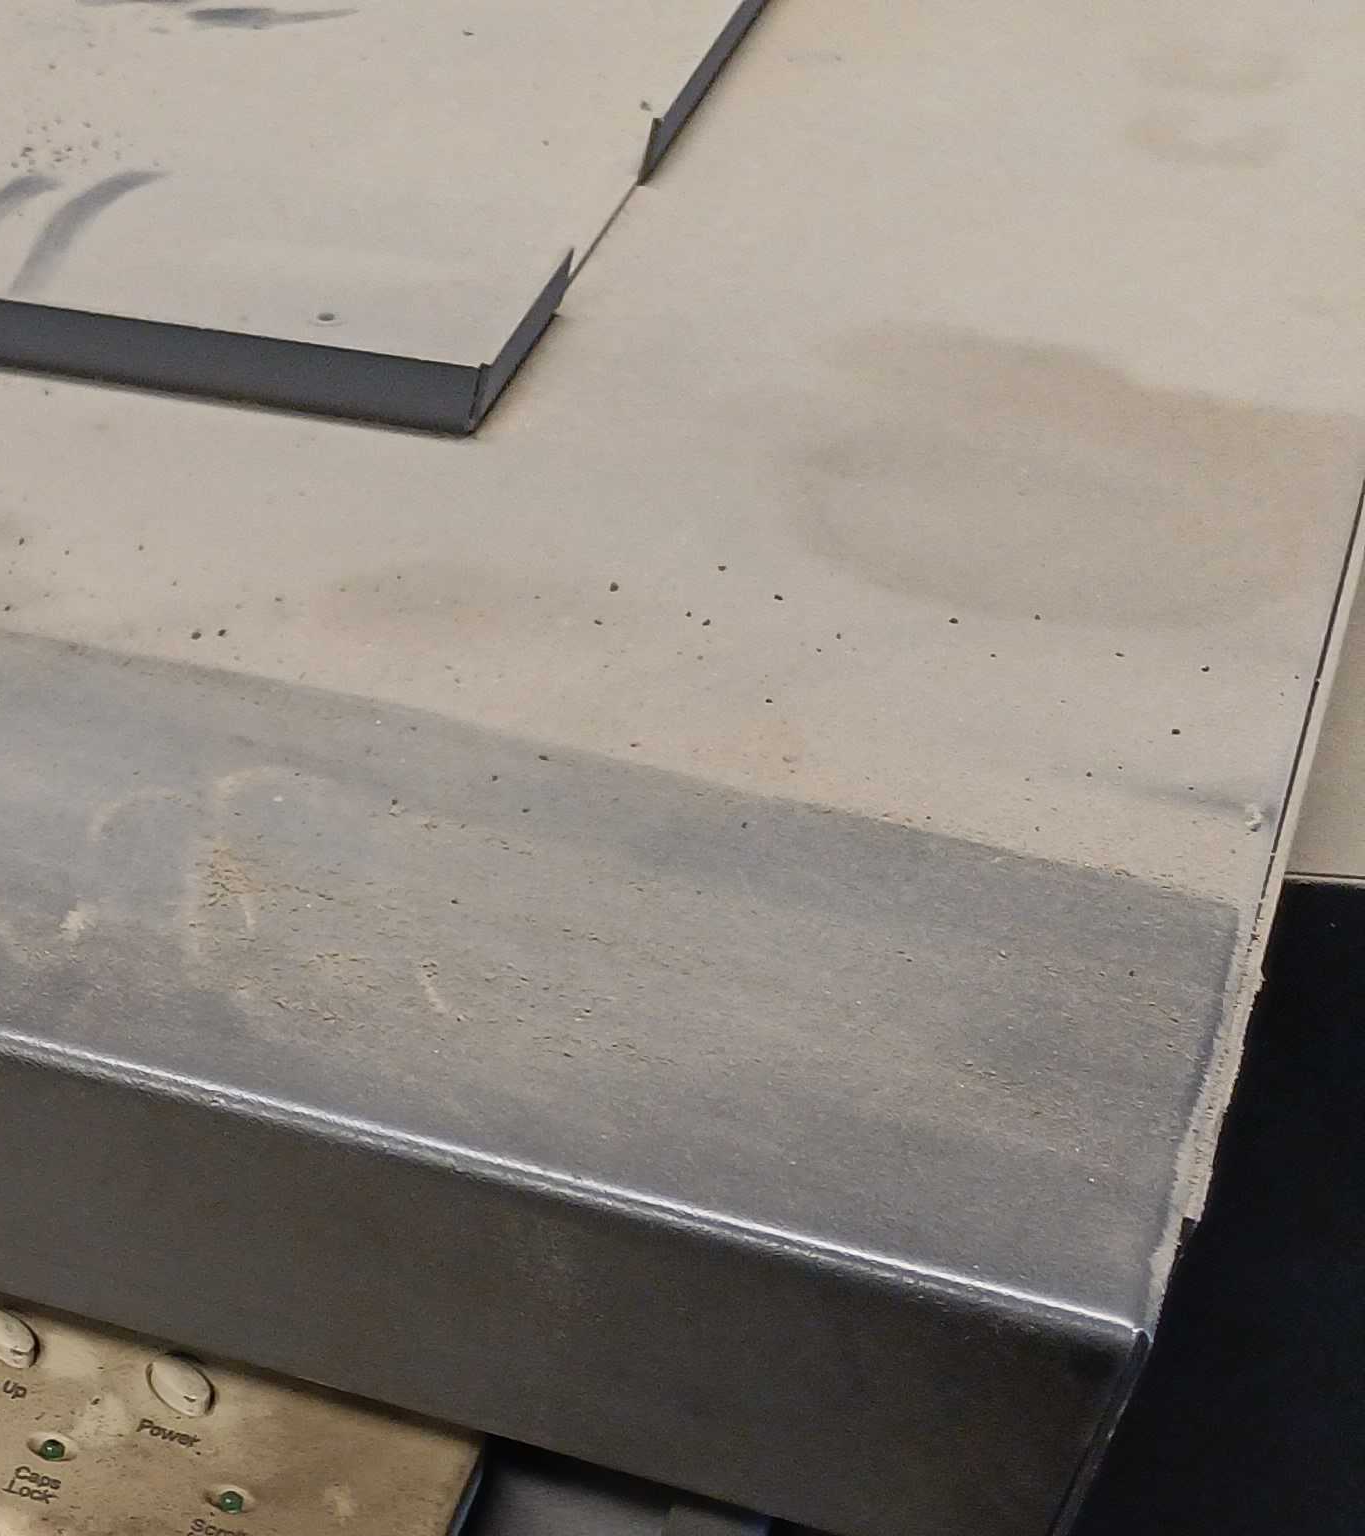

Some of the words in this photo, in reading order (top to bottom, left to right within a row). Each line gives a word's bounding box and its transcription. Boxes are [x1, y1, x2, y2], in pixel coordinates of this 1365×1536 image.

[2, 1380, 28, 1399] Up
[136, 1418, 200, 1448] Power
[15, 1465, 61, 1490] Caps
[9, 1480, 57, 1504] Lock
